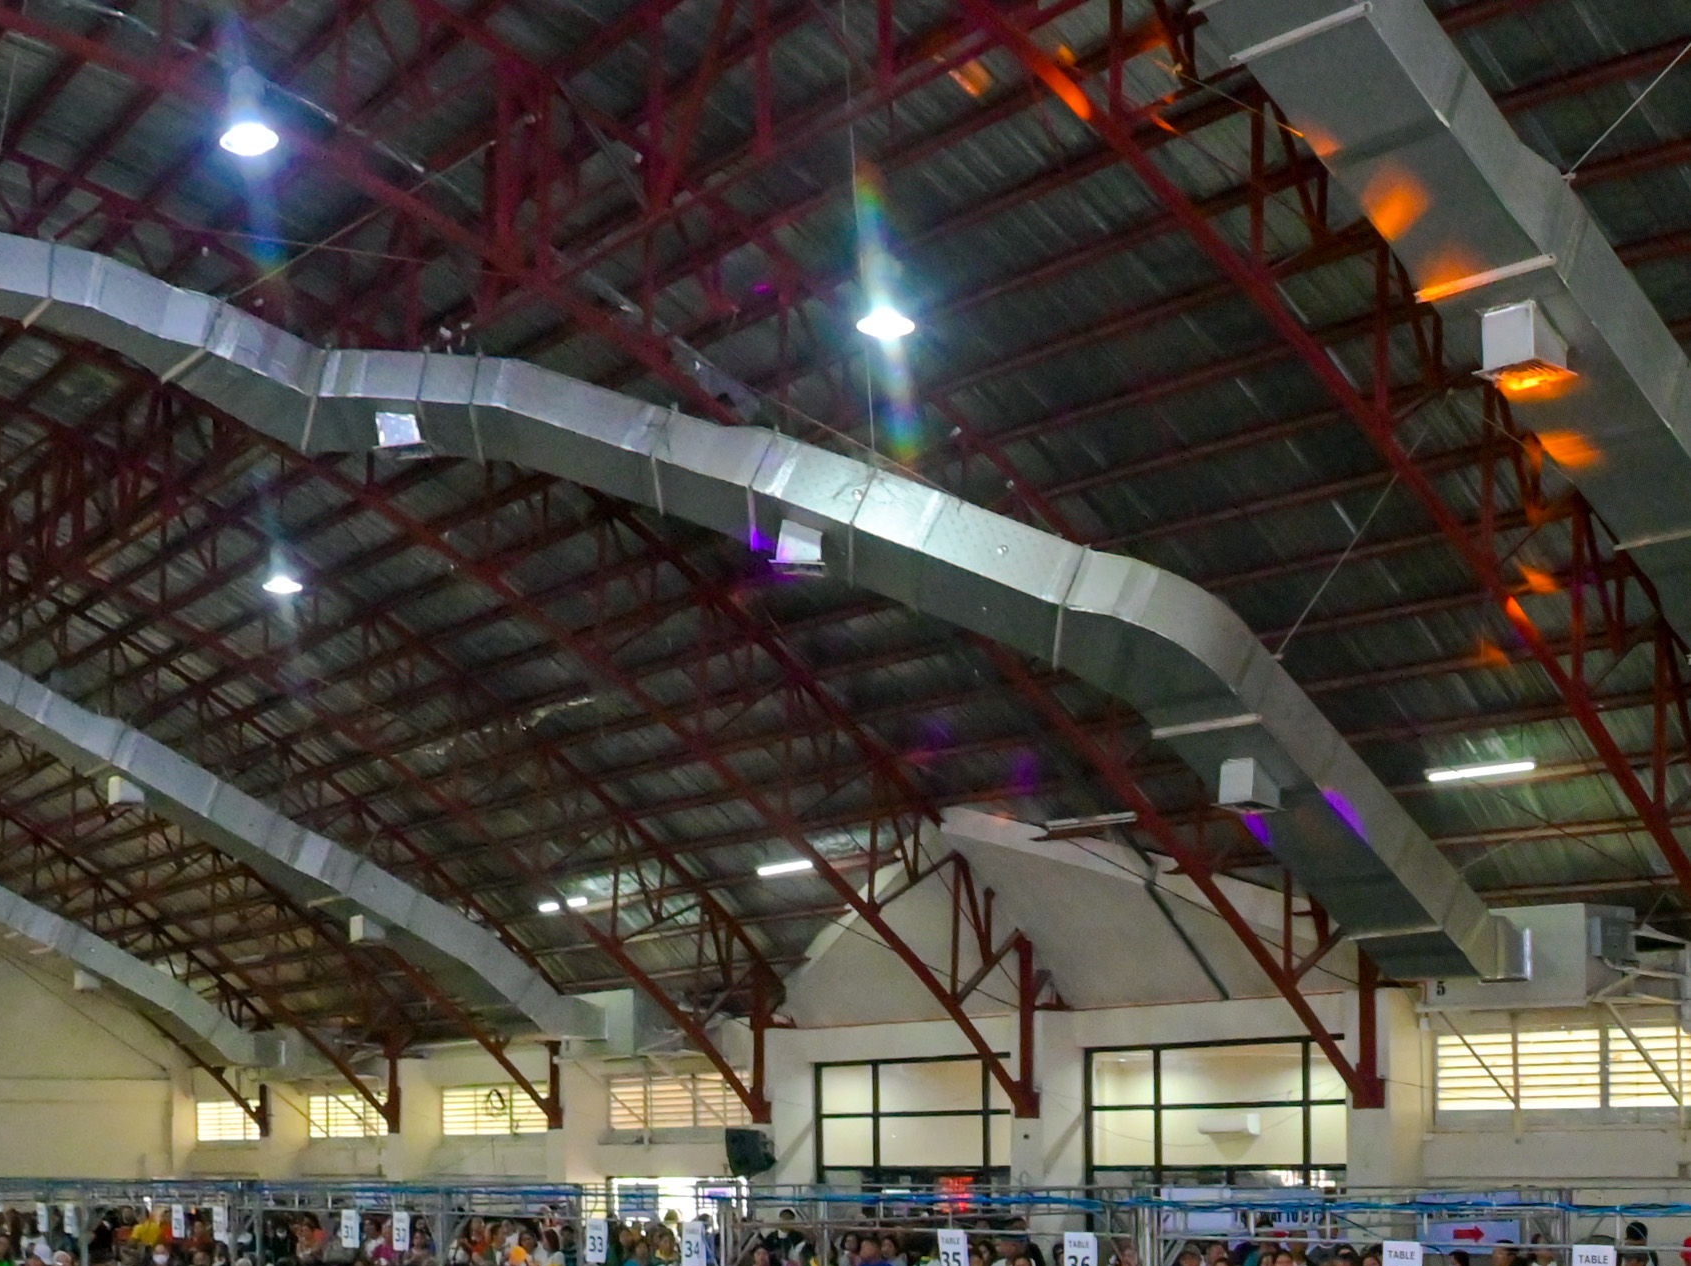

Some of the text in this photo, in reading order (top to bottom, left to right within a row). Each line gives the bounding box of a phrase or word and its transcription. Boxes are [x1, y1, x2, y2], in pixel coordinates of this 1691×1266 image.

[588, 1235, 603, 1252] 33
[941, 1236, 961, 1245] TABLE
[1068, 1240, 1090, 1249] TABLE
[684, 1240, 700, 1259] 34
[1388, 1250, 1415, 1260] TABLE
[1578, 1254, 1609, 1265] TABLE
